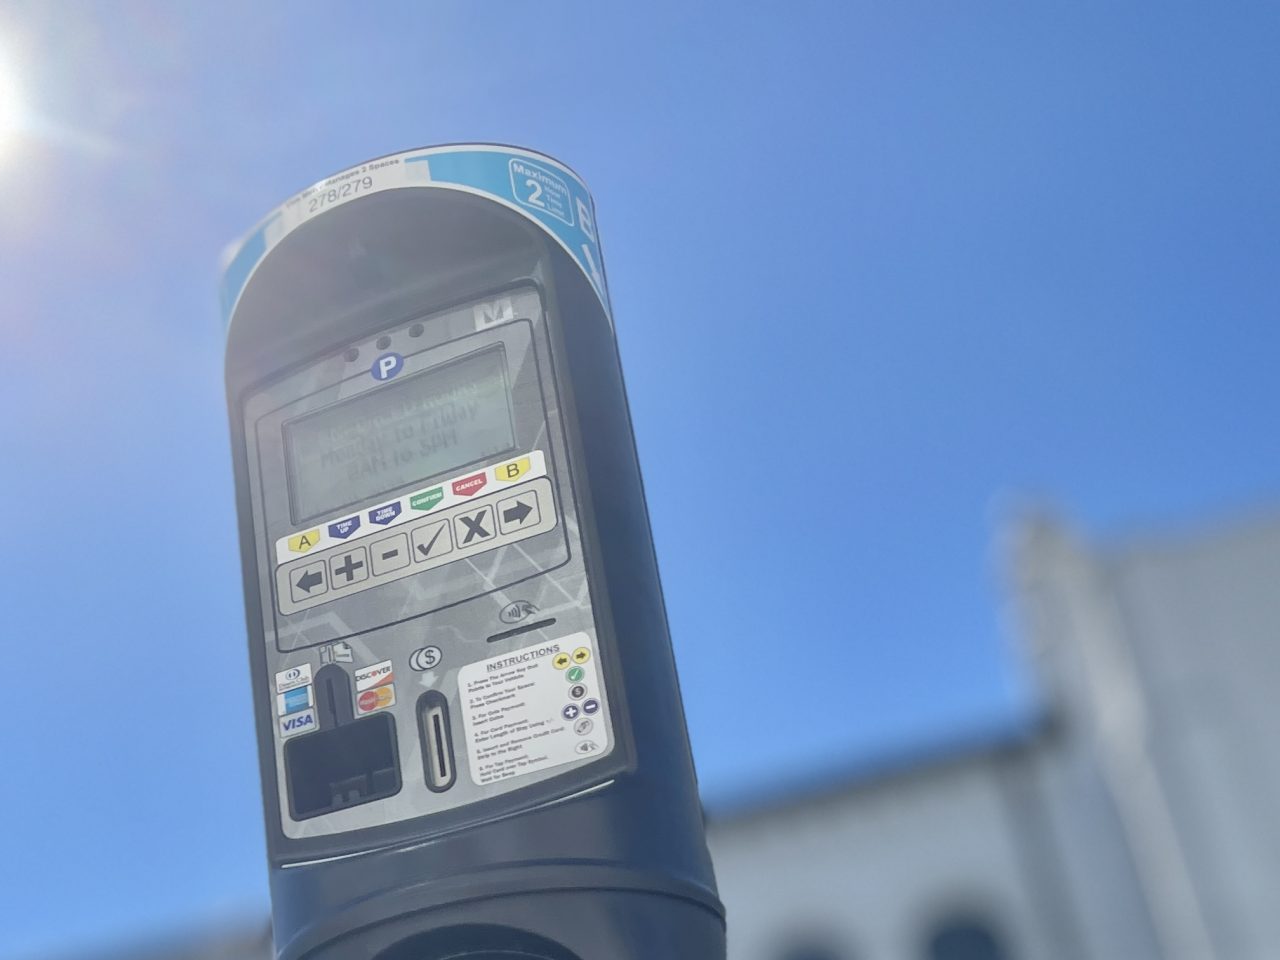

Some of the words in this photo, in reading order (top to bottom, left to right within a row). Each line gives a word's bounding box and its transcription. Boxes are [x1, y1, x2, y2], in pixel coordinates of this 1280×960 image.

[369, 159, 400, 171] Spaces
[513, 163, 567, 196] Maximum
[308, 176, 373, 213] 278/279
[525, 179, 545, 207] 2
[379, 356, 397, 379] P
[507, 463, 520, 478] B
[455, 478, 483, 492] CANCEL
[412, 492, 443, 507] CONFIRM
[375, 510, 396, 521] DOWN
[376, 506, 393, 516] TIME
[336, 520, 353, 529] TIME
[339, 526, 349, 534] UP
[298, 536, 311, 550] A
[486, 644, 560, 672] INSTRUCTIONS
[355, 666, 391, 682] DISCOVER
[283, 714, 313, 731] VISA
